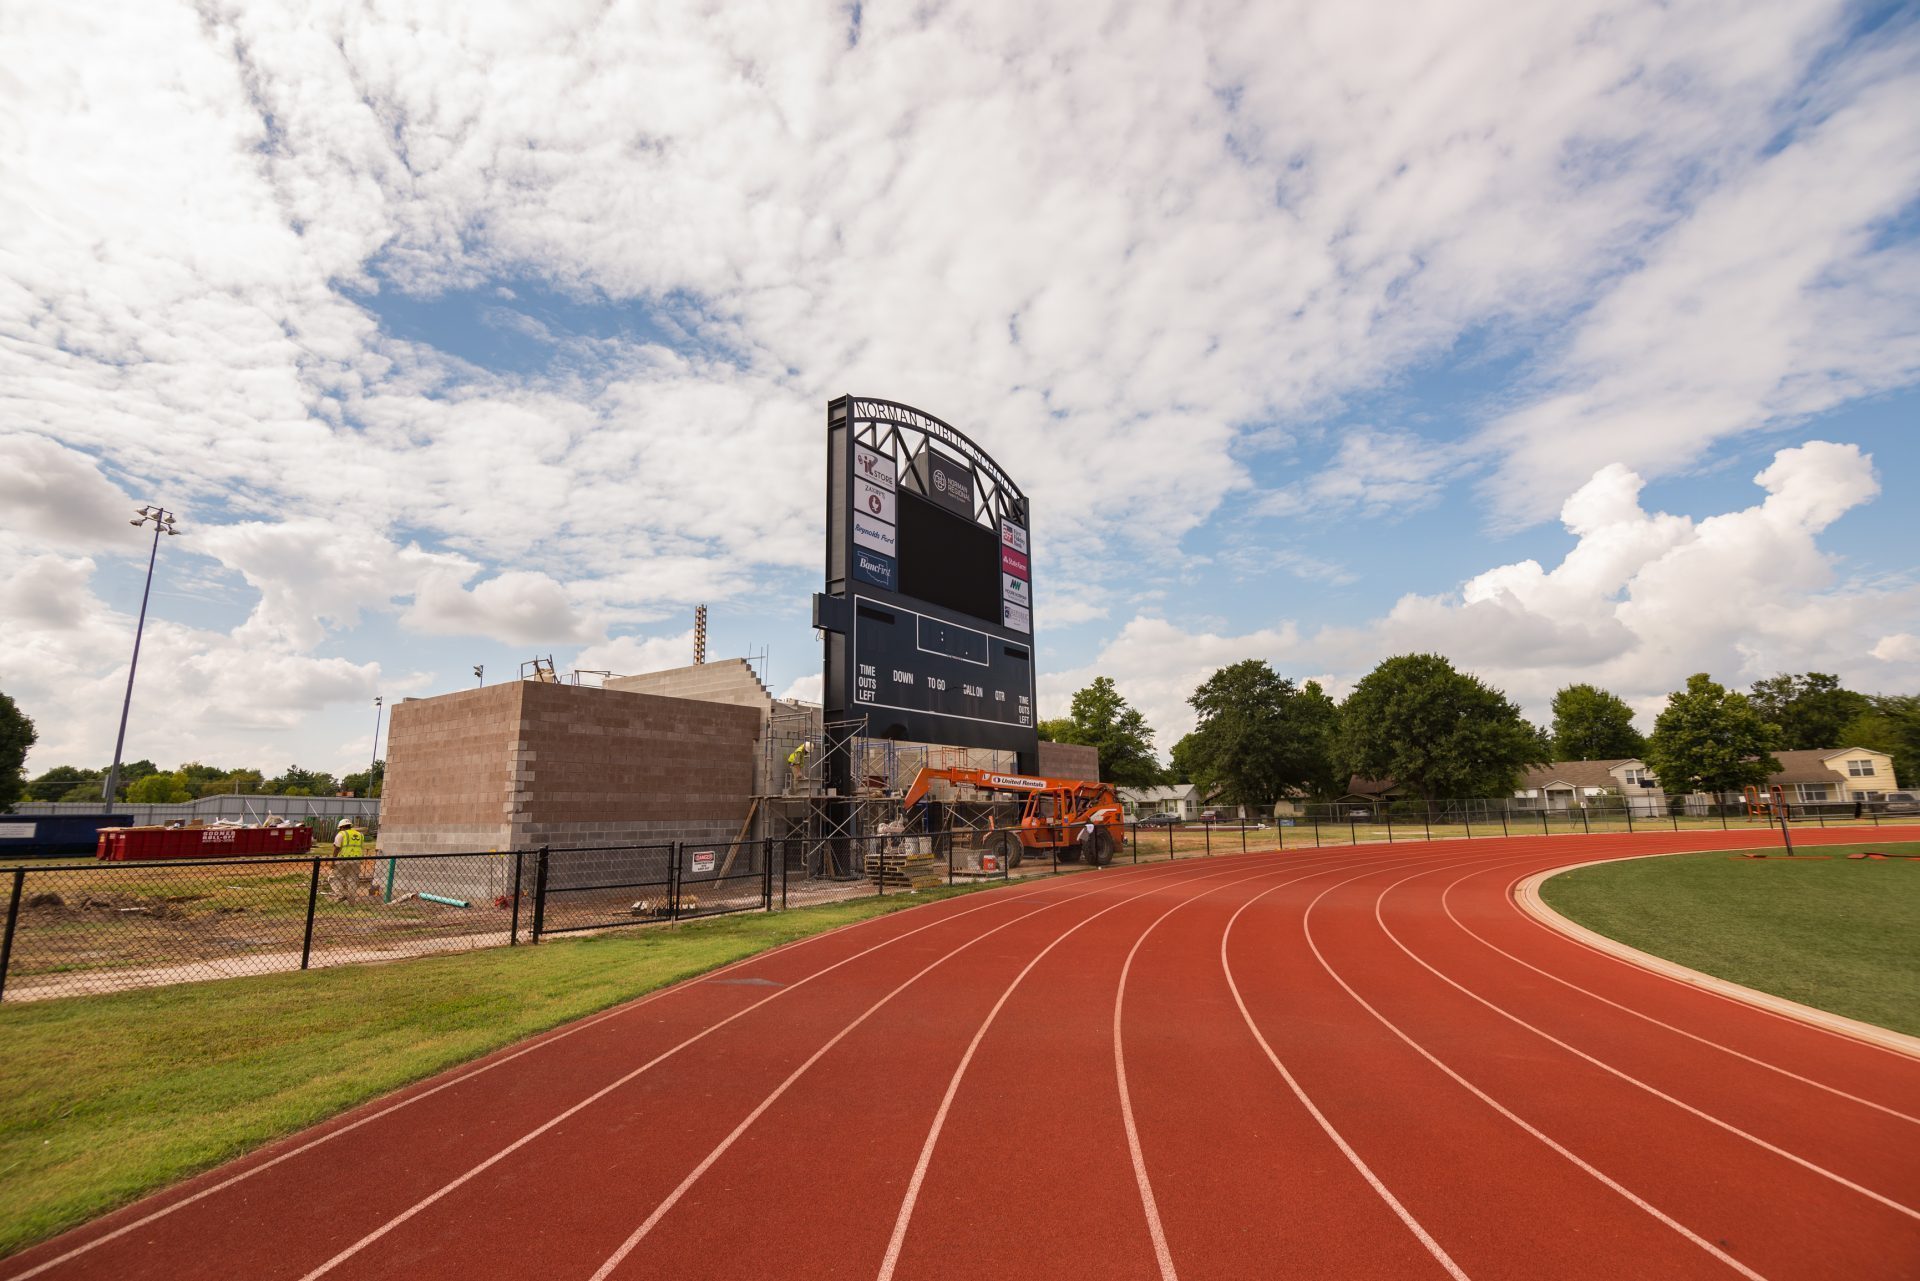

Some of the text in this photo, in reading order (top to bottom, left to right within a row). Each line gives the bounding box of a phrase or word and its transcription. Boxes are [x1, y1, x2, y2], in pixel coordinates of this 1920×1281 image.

[856, 401, 1017, 497] NORMAN PUBLIC SCHOOL
[873, 470, 893, 485] STORE
[855, 523, 894, 545] Reynolds Ford
[859, 557, 891, 577] BancFirst
[859, 664, 876, 677] TIME
[893, 669, 914, 685] DOWN
[858, 678, 877, 690] OUTS
[927, 677, 946, 691] TO GO
[859, 690, 875, 702] LEFT
[975, 686, 984, 698] ON
[994, 690, 1006, 702] QTR
[1018, 695, 1029, 705] TIME
[1018, 705, 1030, 715] OUTS
[1019, 715, 1030, 725] LEFT
[1001, 778, 1045, 788] United Rentals
